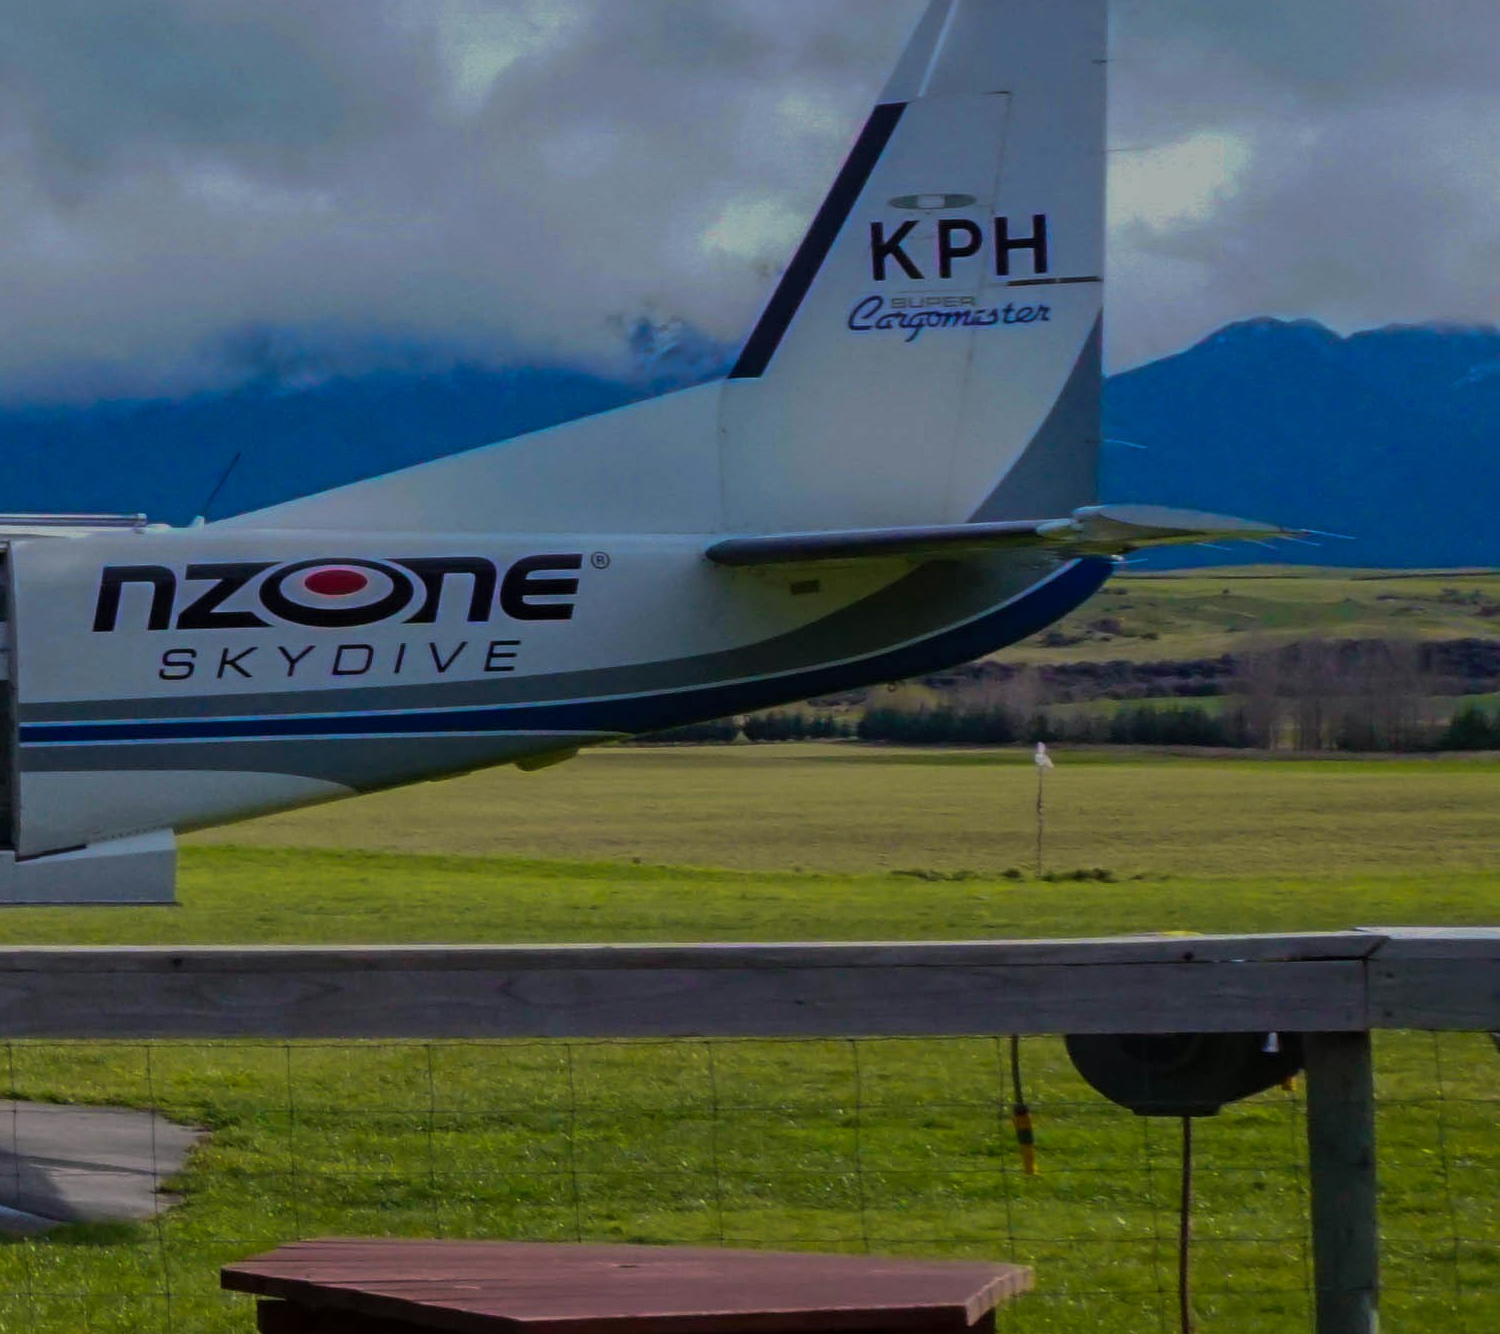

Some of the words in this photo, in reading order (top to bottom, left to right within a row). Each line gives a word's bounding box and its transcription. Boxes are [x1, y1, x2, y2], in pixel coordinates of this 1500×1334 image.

[870, 214, 1047, 281] KPH
[891, 296, 976, 308] SUPER
[158, 640, 521, 680] SKYDIVE
